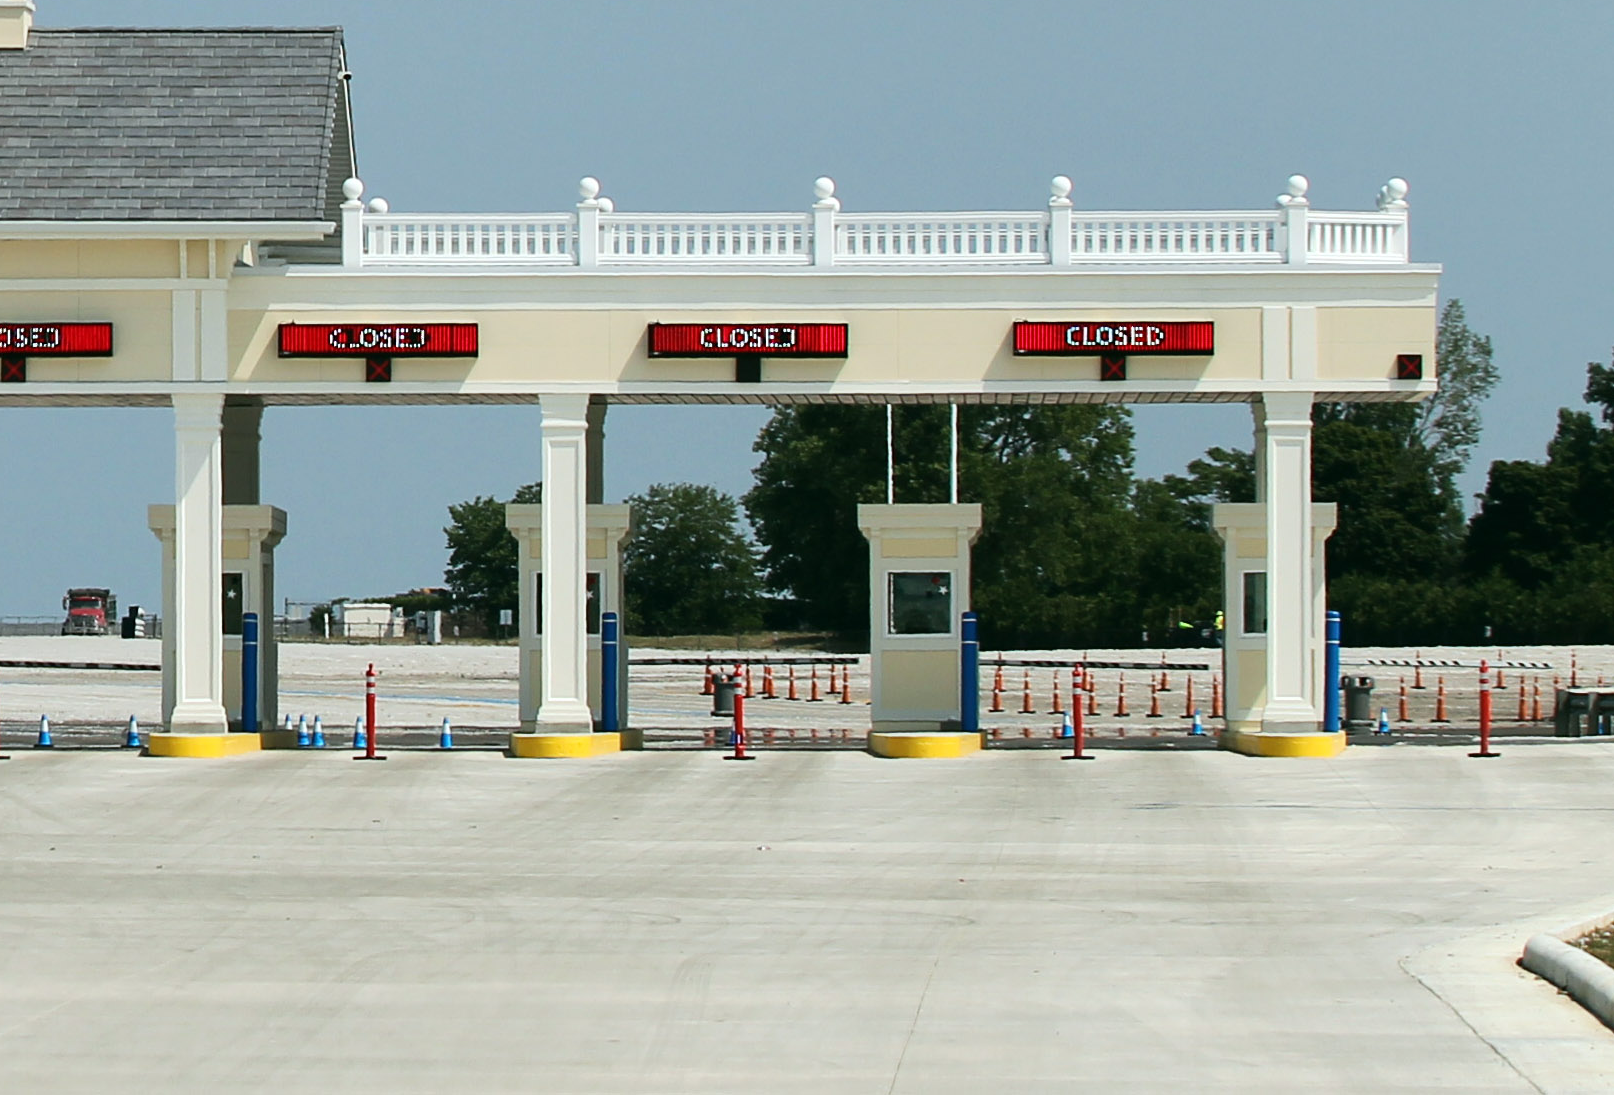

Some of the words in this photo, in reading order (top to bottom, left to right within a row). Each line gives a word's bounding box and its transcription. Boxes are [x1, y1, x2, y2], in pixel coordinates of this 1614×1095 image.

[329, 328, 425, 349] CLOSED
[700, 328, 796, 348] CLOSED
[1066, 326, 1164, 346] CLOSED
